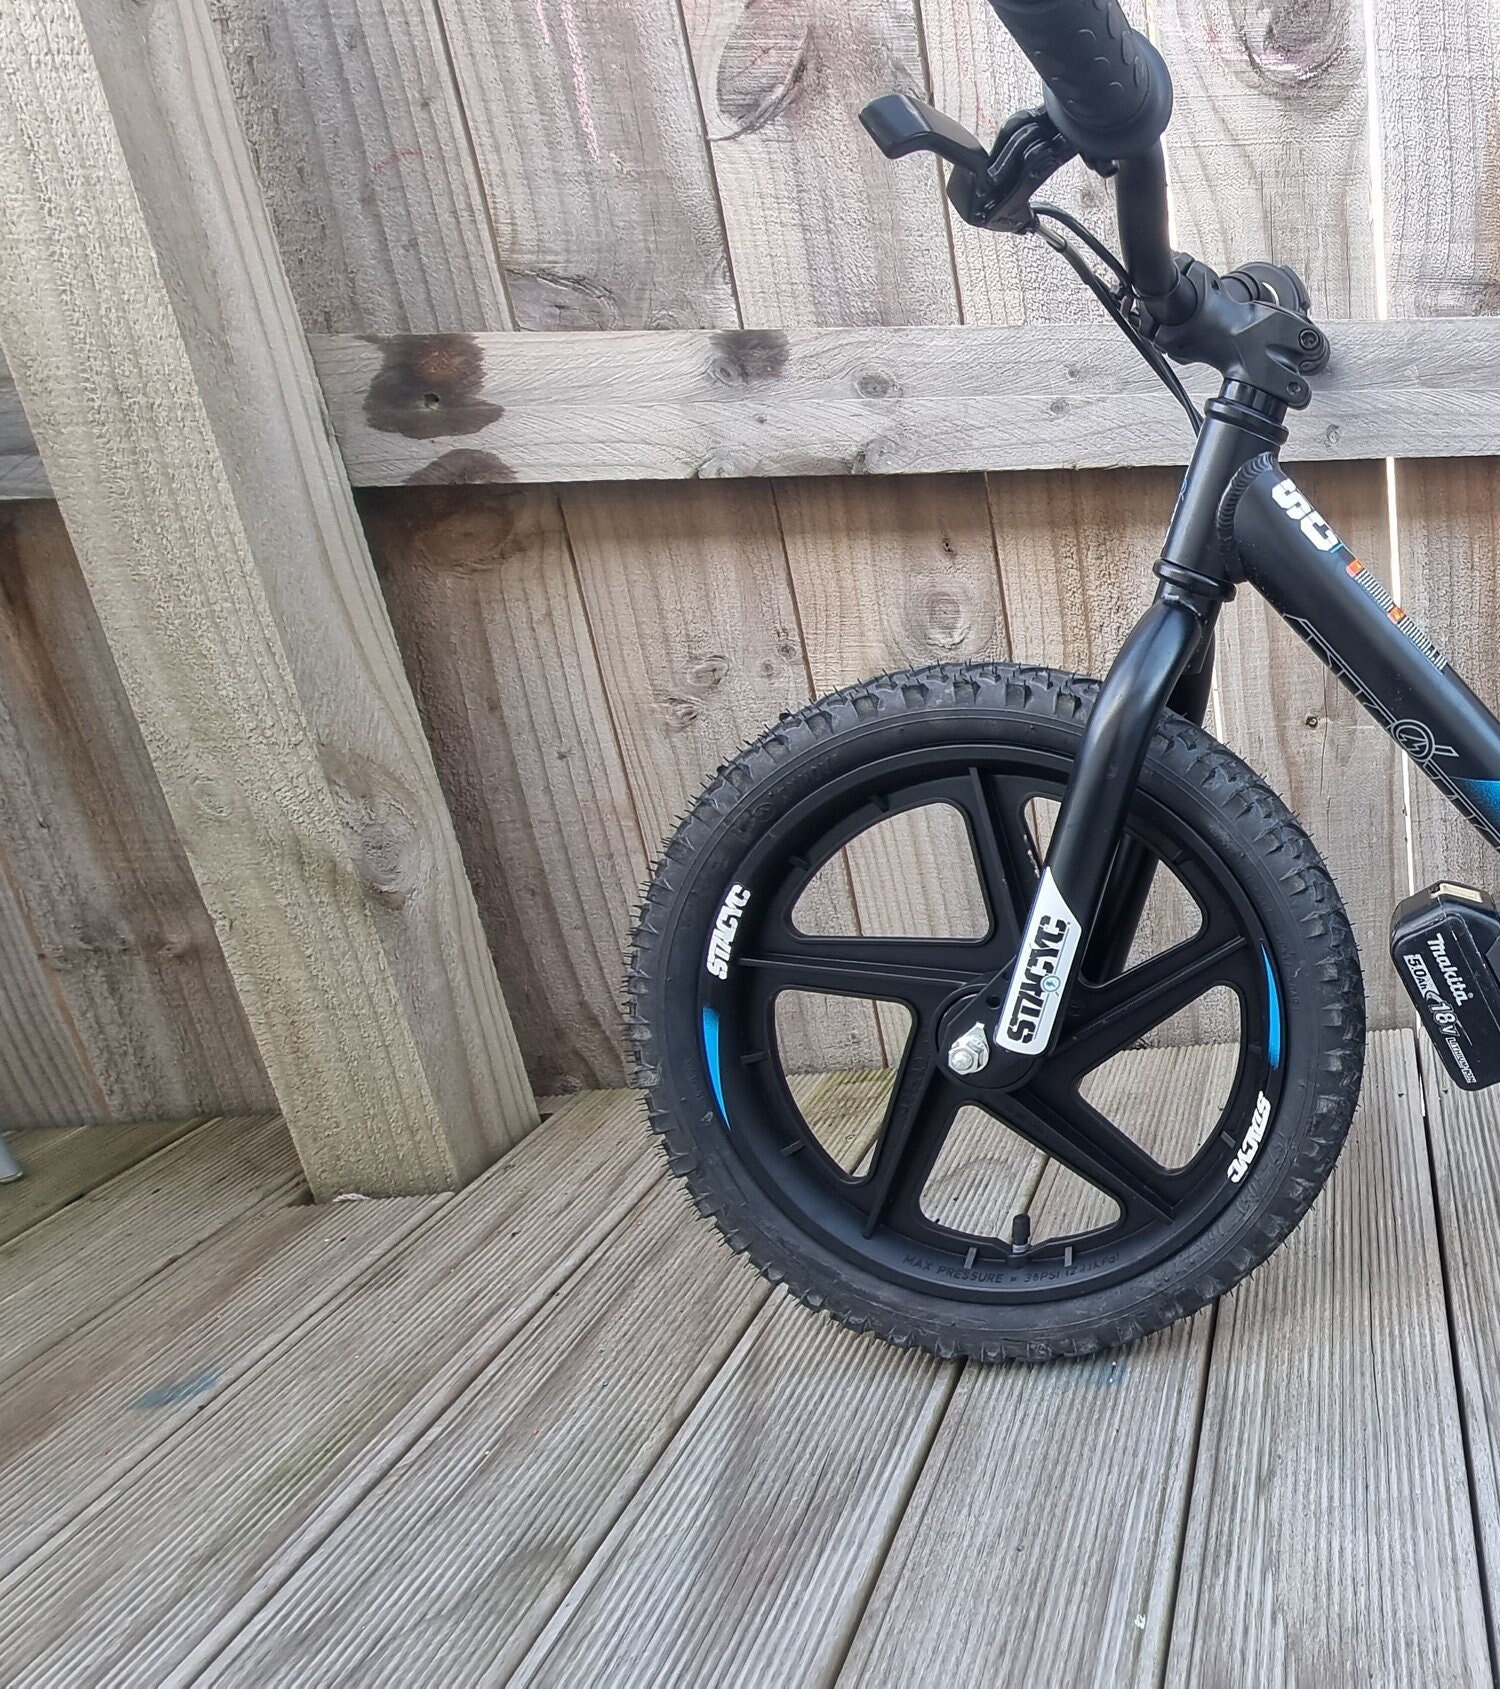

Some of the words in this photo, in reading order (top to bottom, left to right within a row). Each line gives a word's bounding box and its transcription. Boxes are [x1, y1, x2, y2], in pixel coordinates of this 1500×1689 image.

[706, 883, 752, 980] STACYC
[1006, 914, 1068, 1045] STACYC
[1226, 1090, 1272, 1184] STACYC
[901, 1253, 934, 1272] MAX
[936, 1264, 1005, 1284] PRESSURE
